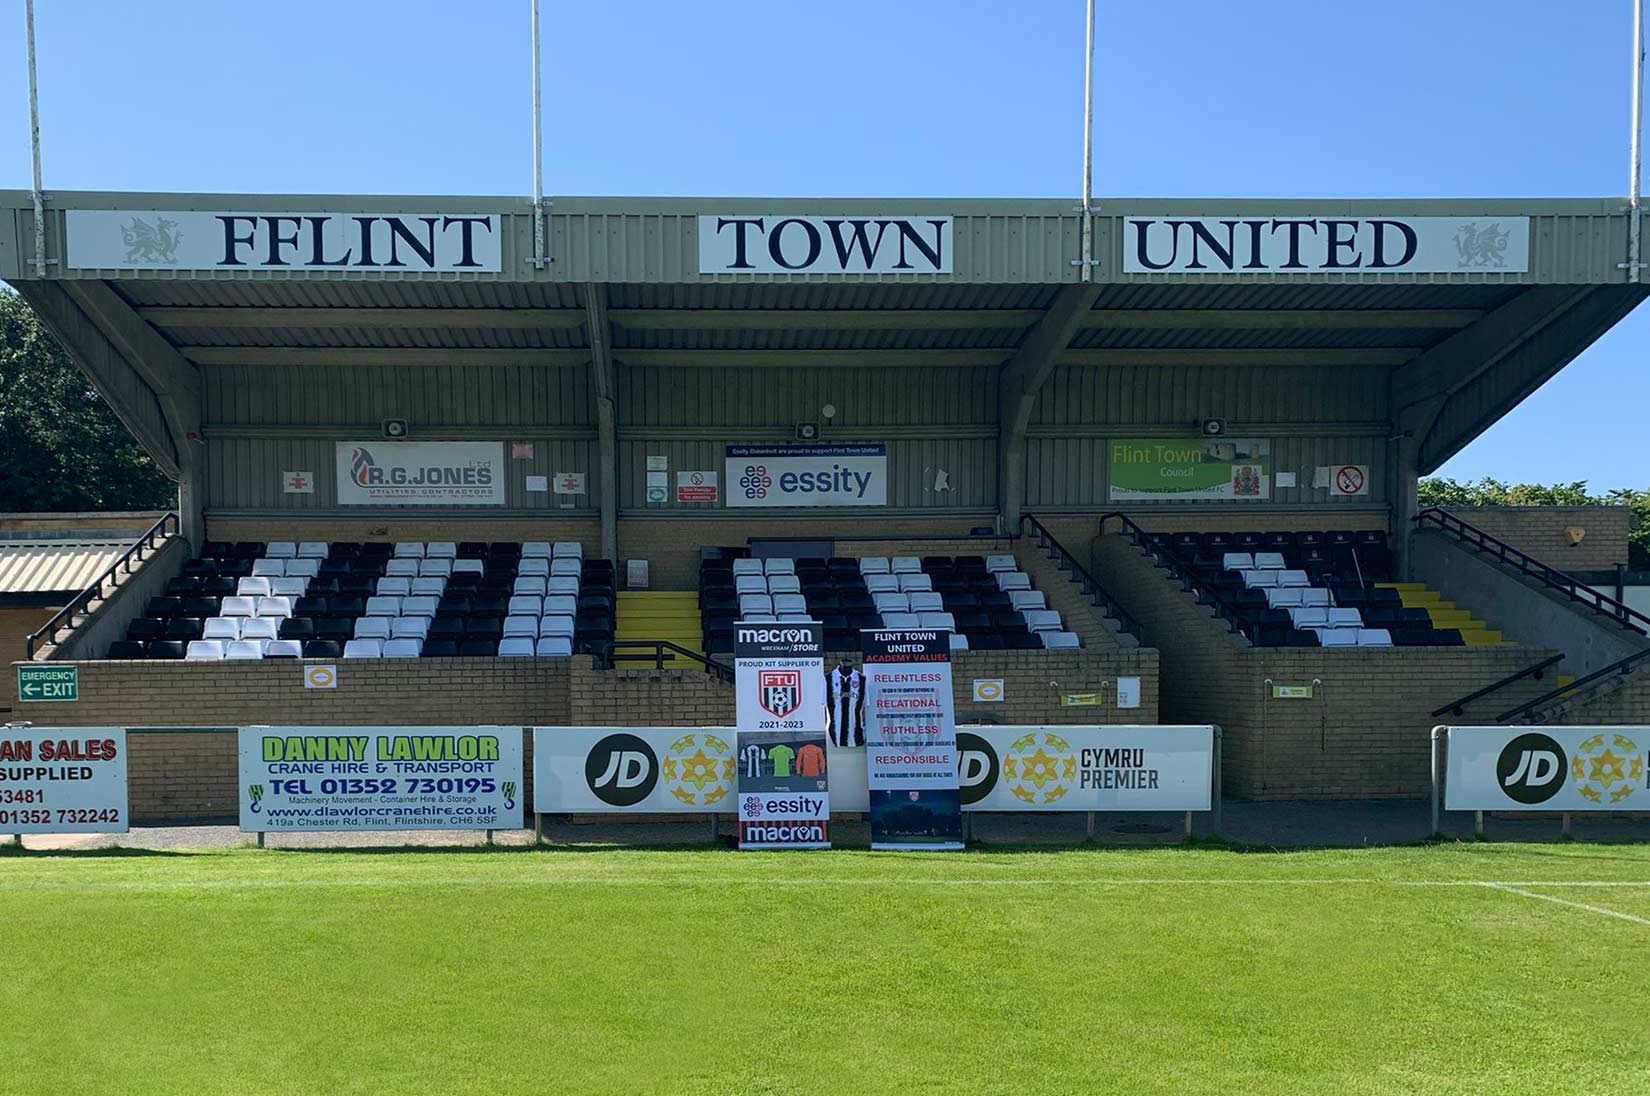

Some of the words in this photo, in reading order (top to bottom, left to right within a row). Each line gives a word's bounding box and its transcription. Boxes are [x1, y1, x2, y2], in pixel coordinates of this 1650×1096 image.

[215, 215, 492, 268] FFLINT
[717, 217, 948, 270] TOWN
[1129, 218, 1418, 270] UNITED
[1112, 445, 1151, 464] Flint
[1154, 445, 1202, 464] Town
[368, 467, 492, 485] R.G.JONES
[1160, 466, 1194, 477] Council
[779, 464, 872, 498] essity
[738, 629, 812, 643] macron
[874, 633, 902, 641] FLINT
[906, 633, 936, 641] TOWN
[887, 644, 925, 653] UNITED
[866, 654, 910, 662] ACADEMY
[913, 653, 948, 661] VALUES
[21, 671, 75, 680] EMERGENCY
[764, 677, 794, 685] FTU
[874, 674, 942, 682] RELENTLESS
[43, 682, 74, 696] EXIT
[877, 699, 941, 708] RELATIONAL
[759, 721, 804, 729] 2021-2023
[883, 725, 939, 734] RUTHLESS
[39, 739, 117, 761] SALES
[262, 736, 369, 762] DANNY
[377, 736, 499, 761] LAWLOR
[875, 755, 949, 764] RESPONSIBLE
[1081, 749, 1144, 767] CYMRU
[268, 763, 324, 774] CRANE
[331, 763, 369, 774] HIRE
[375, 763, 388, 773] &
[393, 762, 494, 773] TRANSPORT
[594, 750, 650, 788] JD
[957, 750, 991, 787] D
[1505, 750, 1560, 786] JD
[269, 779, 312, 795] TEL
[320, 779, 397, 795] 01352
[405, 778, 496, 794] 730195
[1080, 770, 1159, 789] PREMIER
[288, 796, 330, 805] Machinery
[331, 796, 372, 804] Movement
[438, 795, 444, 803] &
[446, 795, 477, 804] Storage
[766, 796, 823, 816] essity
[57, 809, 119, 823] 732242
[267, 806, 497, 817] www.dlawlorcranehire.co.uk
[297, 818, 339, 826] Chester
[450, 816, 474, 825] CH6
[477, 816, 498, 825] 5SF
[747, 827, 822, 841] macron
